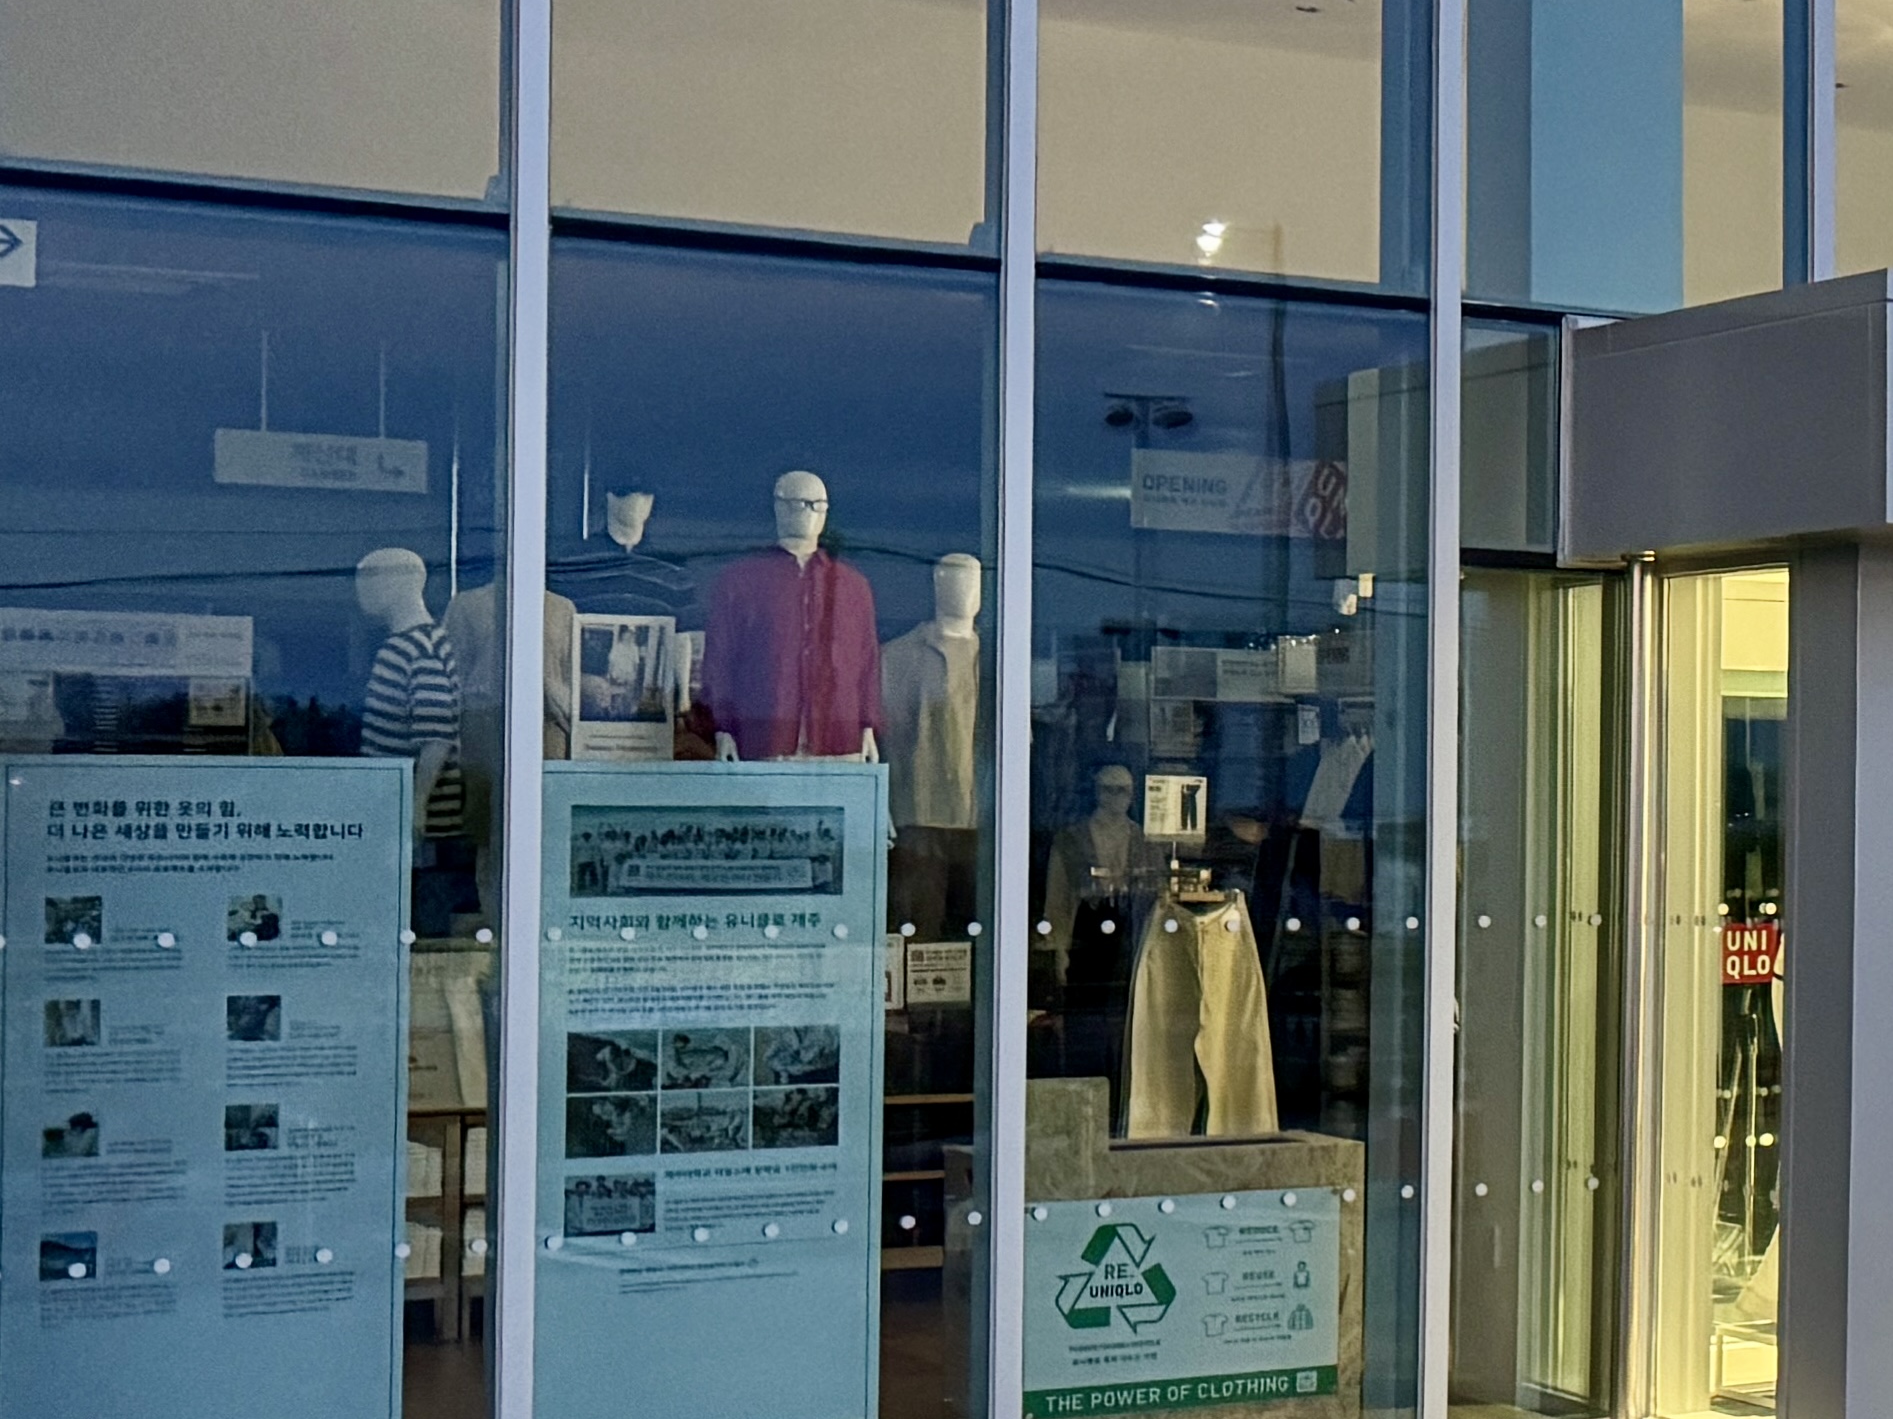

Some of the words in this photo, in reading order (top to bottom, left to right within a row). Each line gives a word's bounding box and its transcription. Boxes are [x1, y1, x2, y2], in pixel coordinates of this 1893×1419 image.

[1143, 474, 1228, 495] OPENING
[73, 801, 127, 817] 변화를
[135, 801, 170, 817] 위한
[178, 801, 211, 817] 옷의
[47, 823, 64, 839] 더
[72, 823, 108, 839] 나은
[115, 823, 168, 839] 세상을
[176, 822, 228, 839] 만들기
[237, 822, 271, 839] 위해
[276, 822, 363, 839] 노력합니다
[791, 911, 821, 928] 제주
[1727, 930, 1767, 951] UNI
[1726, 955, 1770, 979] QLO
[1089, 1282, 1144, 1299] UNIQLO
[1046, 1393, 1084, 1412] THE
[1091, 1387, 1160, 1409] POWER
[1167, 1384, 1193, 1402] OF
[1198, 1376, 1289, 1400] CLOTHING
